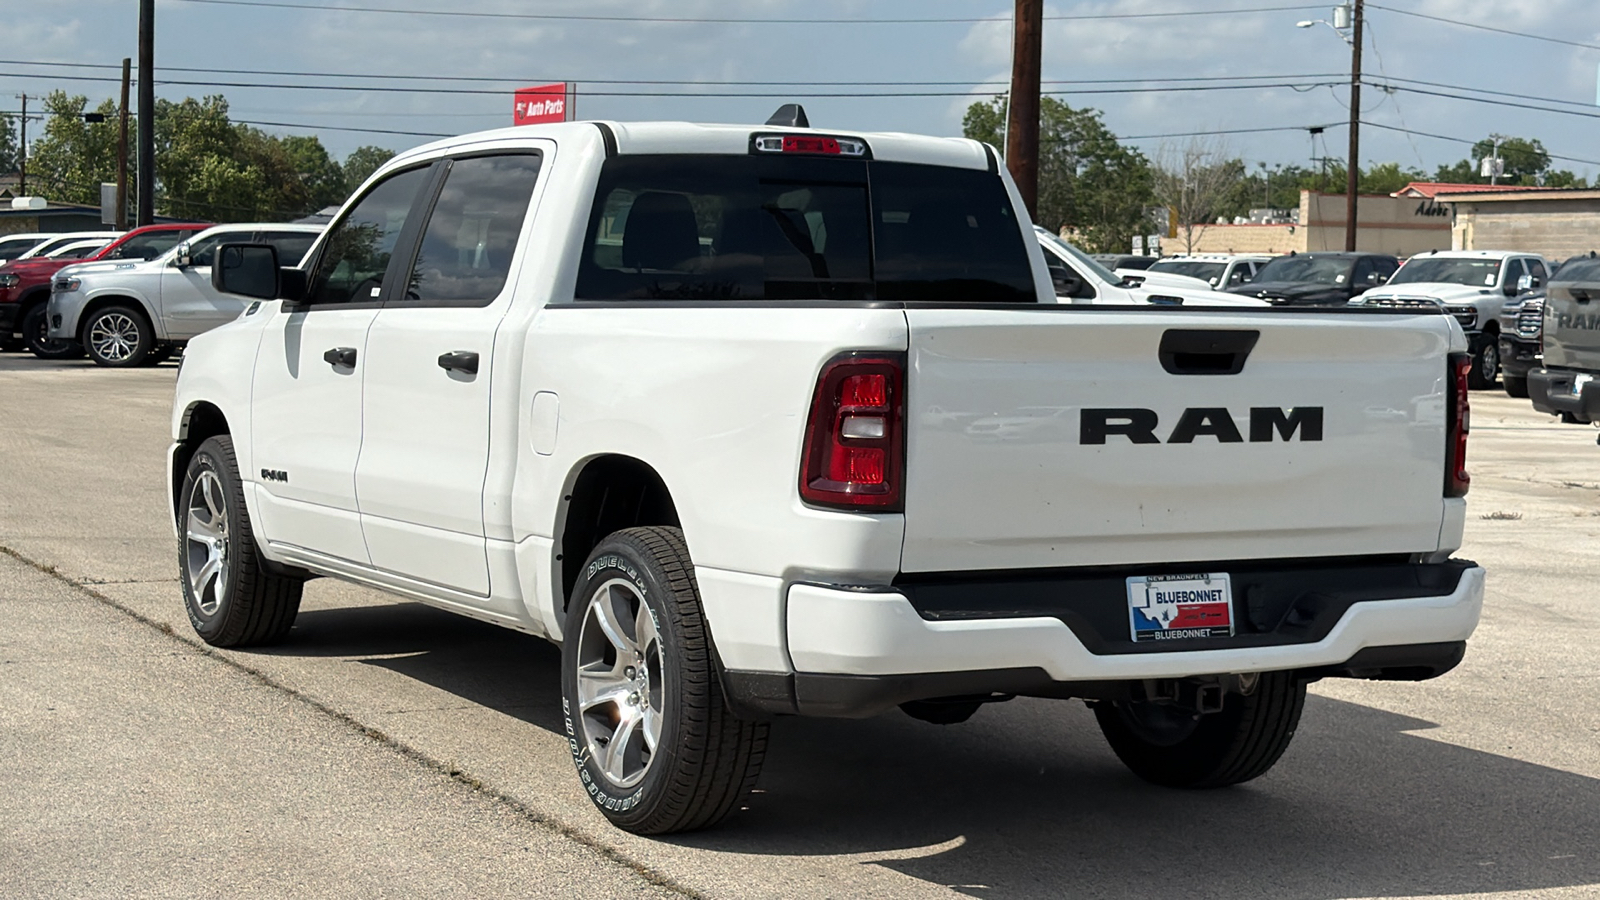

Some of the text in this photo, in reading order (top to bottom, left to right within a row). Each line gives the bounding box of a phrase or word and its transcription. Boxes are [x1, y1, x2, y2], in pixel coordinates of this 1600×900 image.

[527, 99, 564, 117] Auto Parts
[1079, 406, 1324, 445] RAM
[261, 468, 288, 483] RAM
[587, 555, 647, 596] DUELER
[1156, 589, 1223, 604] BLUEBONNET
[1155, 628, 1212, 640] BLUEBONNET
